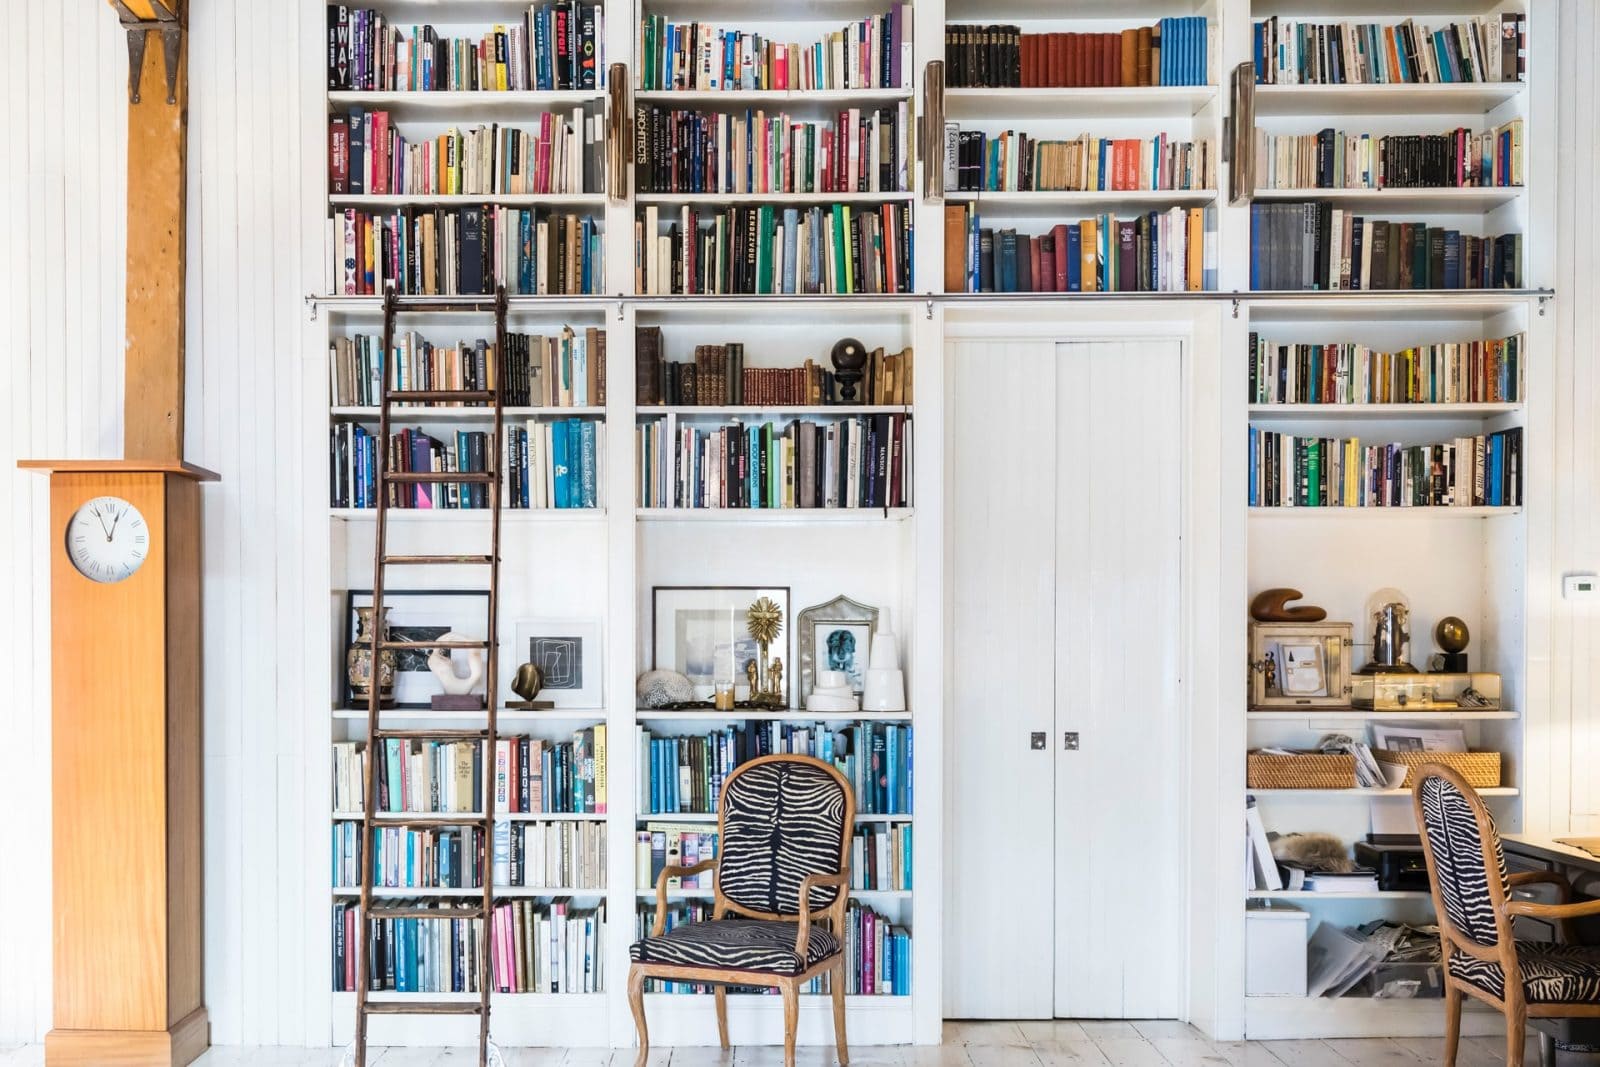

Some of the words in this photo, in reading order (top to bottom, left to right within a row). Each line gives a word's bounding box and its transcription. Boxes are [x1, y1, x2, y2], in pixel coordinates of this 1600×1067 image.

[558, 12, 567, 56] Ferrari
[637, 108, 646, 164] ARCHITECTS
[946, 132, 958, 172] Esquire
[748, 210, 756, 264] RENDEZVOUS
[584, 426, 592, 442] The
[584, 442, 592, 469] Garden
[584, 470, 592, 490] Book
[498, 751, 506, 803] ENGLAND
